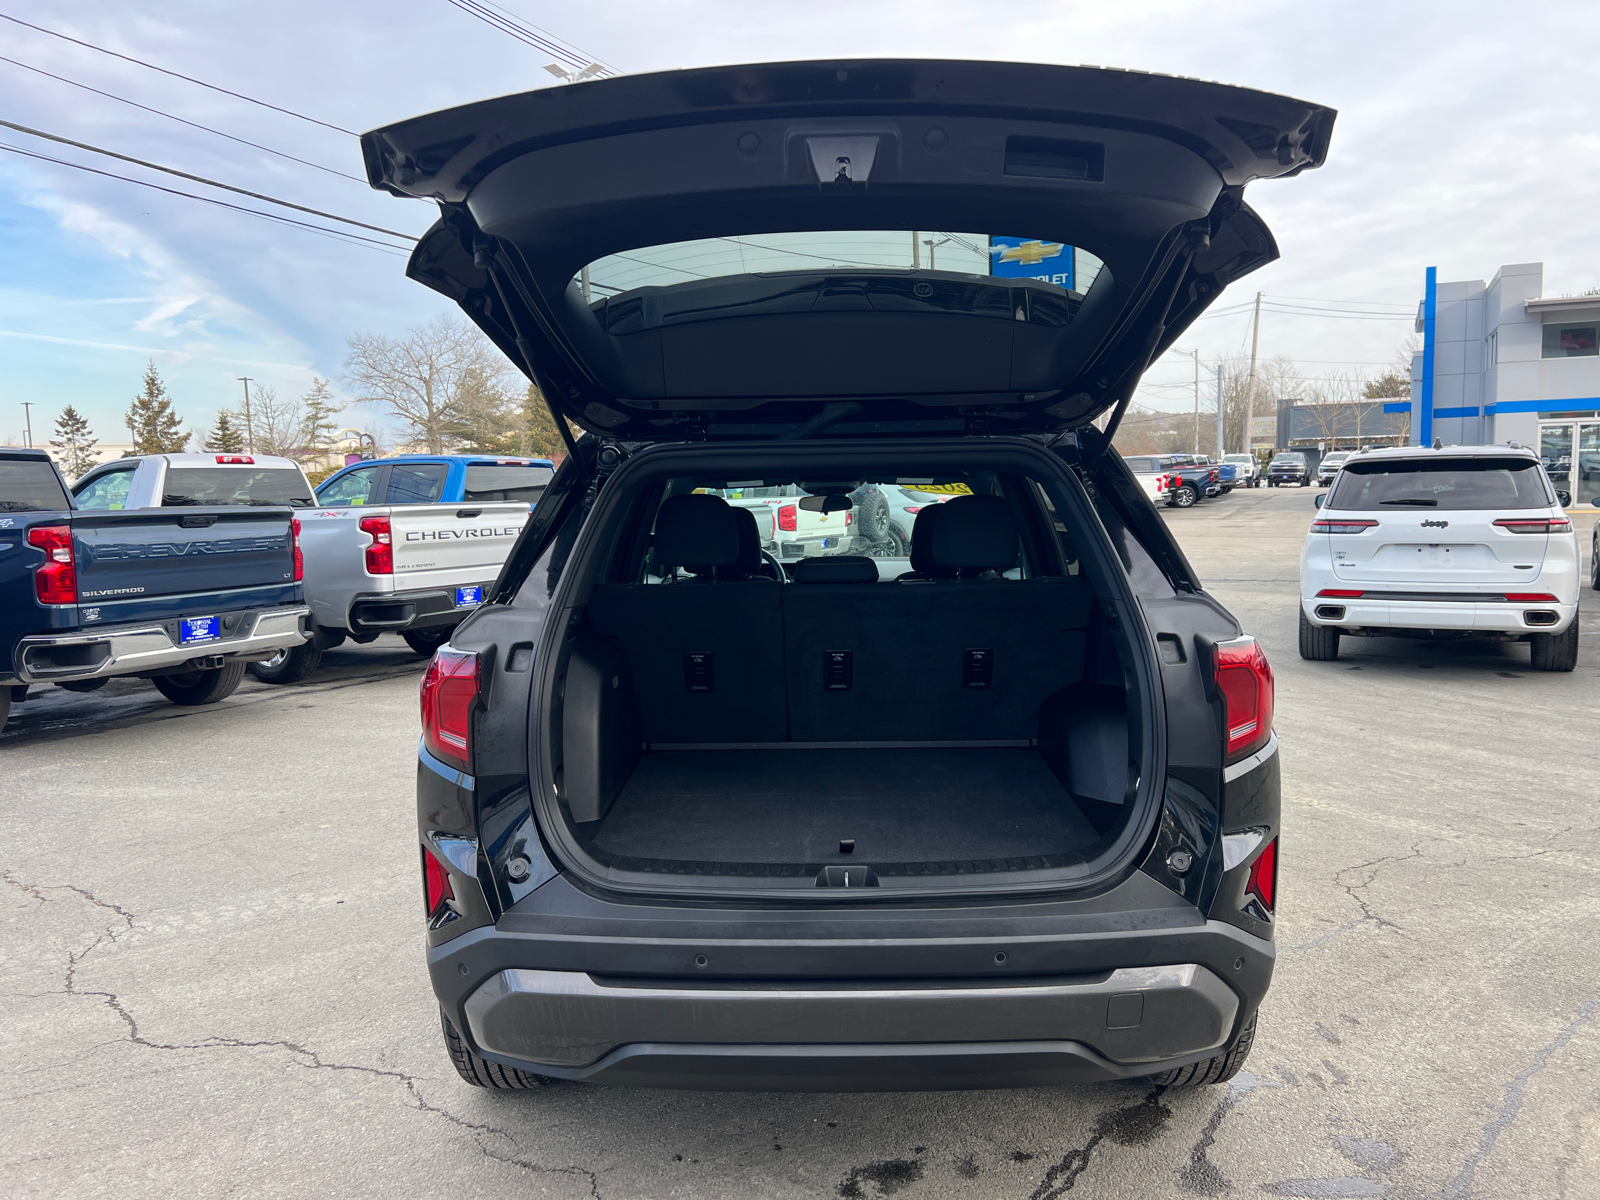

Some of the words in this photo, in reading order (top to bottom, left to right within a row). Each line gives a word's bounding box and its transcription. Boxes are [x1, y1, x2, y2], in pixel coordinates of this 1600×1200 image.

[1420, 519, 1449, 529] Jeep
[96, 538, 285, 561] CHEVROLET
[82, 586, 145, 597] SILVERADO
